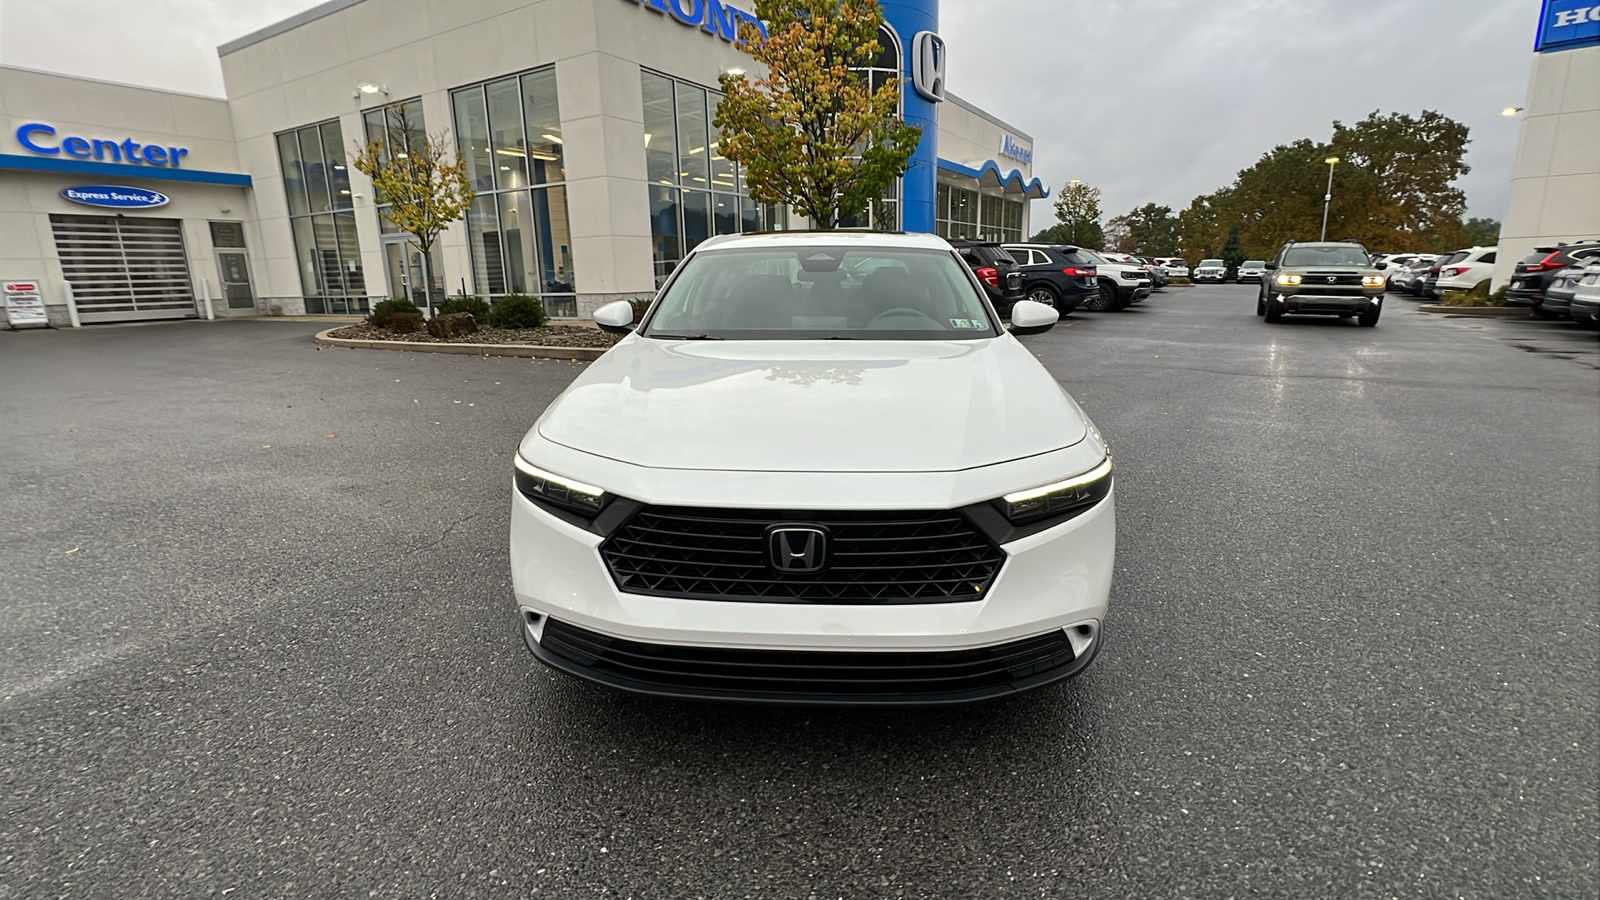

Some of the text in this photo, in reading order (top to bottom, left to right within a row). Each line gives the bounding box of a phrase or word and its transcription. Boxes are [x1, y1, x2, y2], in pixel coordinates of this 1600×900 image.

[16, 122, 189, 168] Center
[67, 189, 149, 202] Express Service
